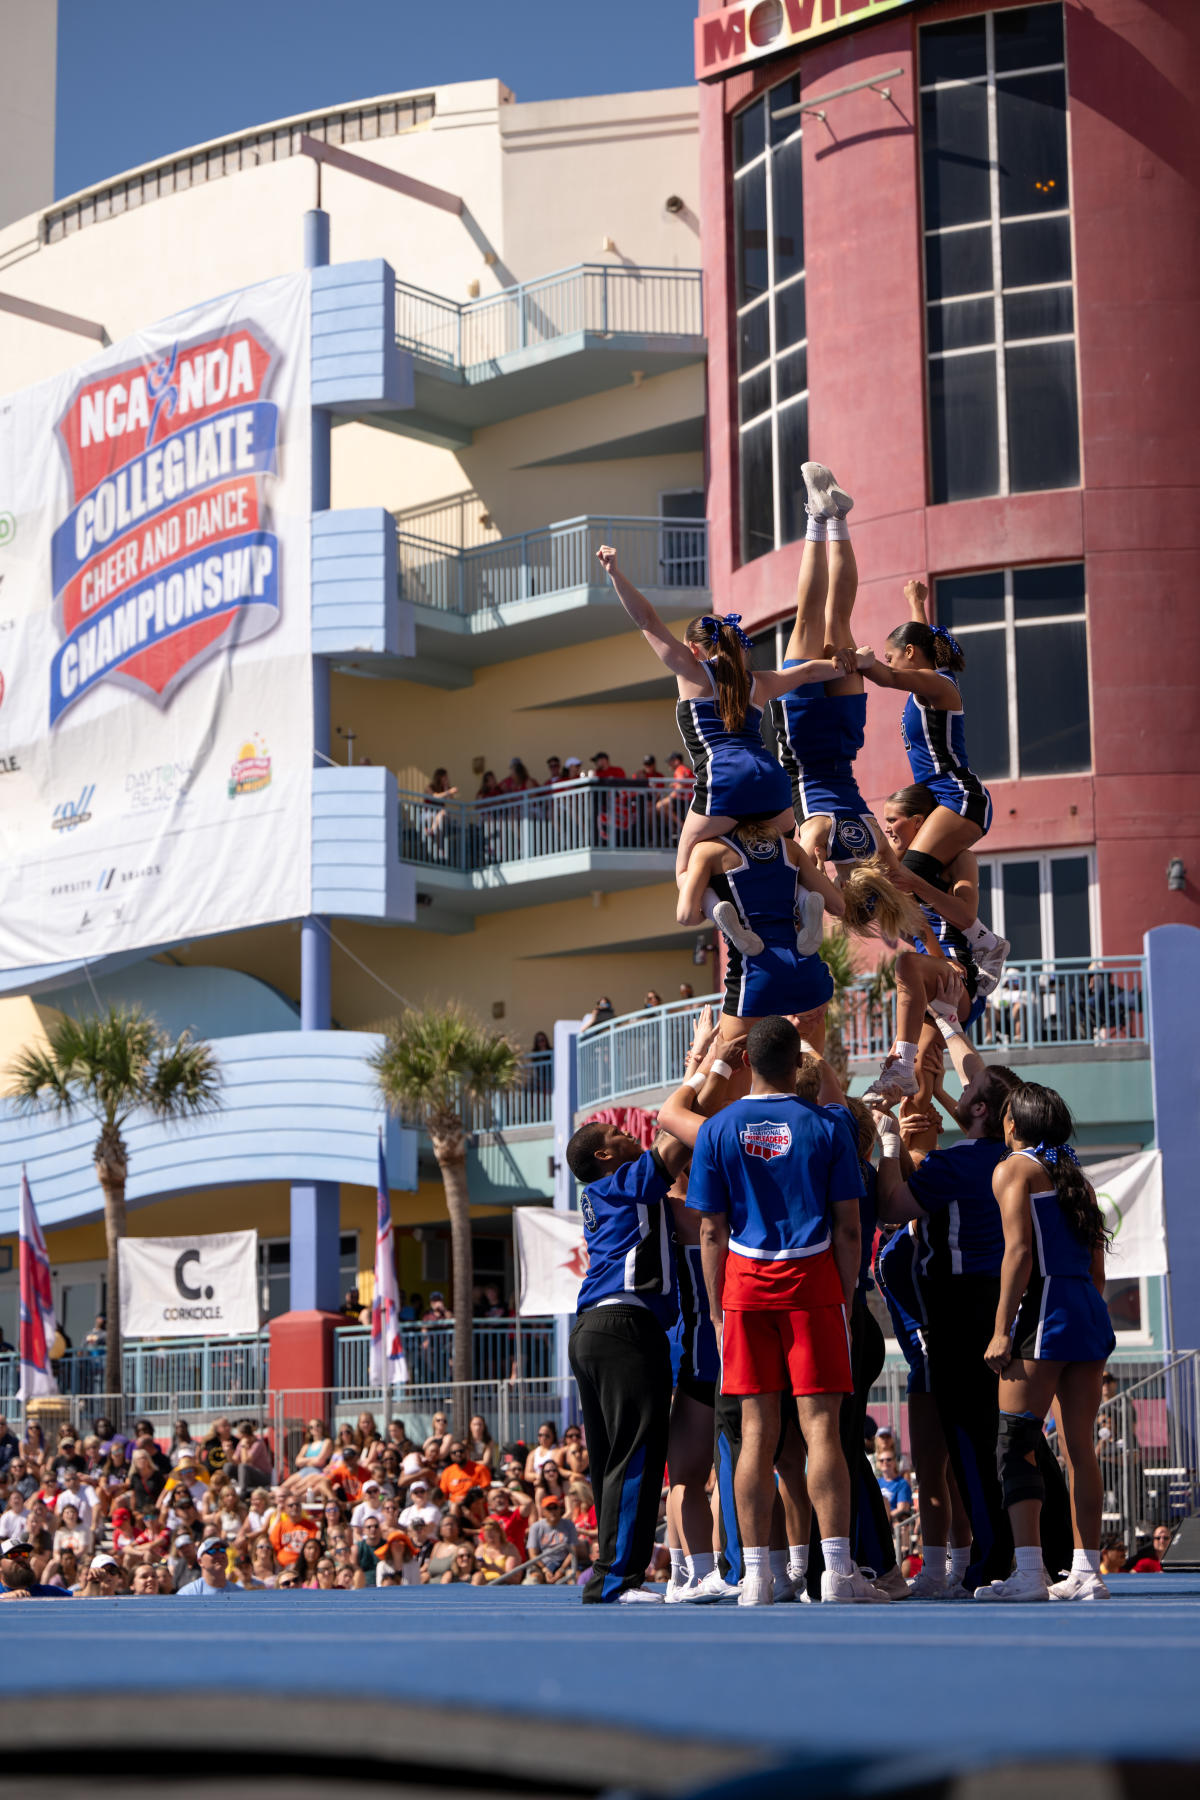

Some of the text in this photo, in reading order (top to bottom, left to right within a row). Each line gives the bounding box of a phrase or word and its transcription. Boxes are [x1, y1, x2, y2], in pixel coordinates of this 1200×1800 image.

[80, 339, 254, 448] NCA NDA
[75, 410, 254, 561] COLLEGIATE
[80, 487, 248, 613] CHEER AND DANCE
[60, 545, 273, 698] CHAMPIONSHIP
